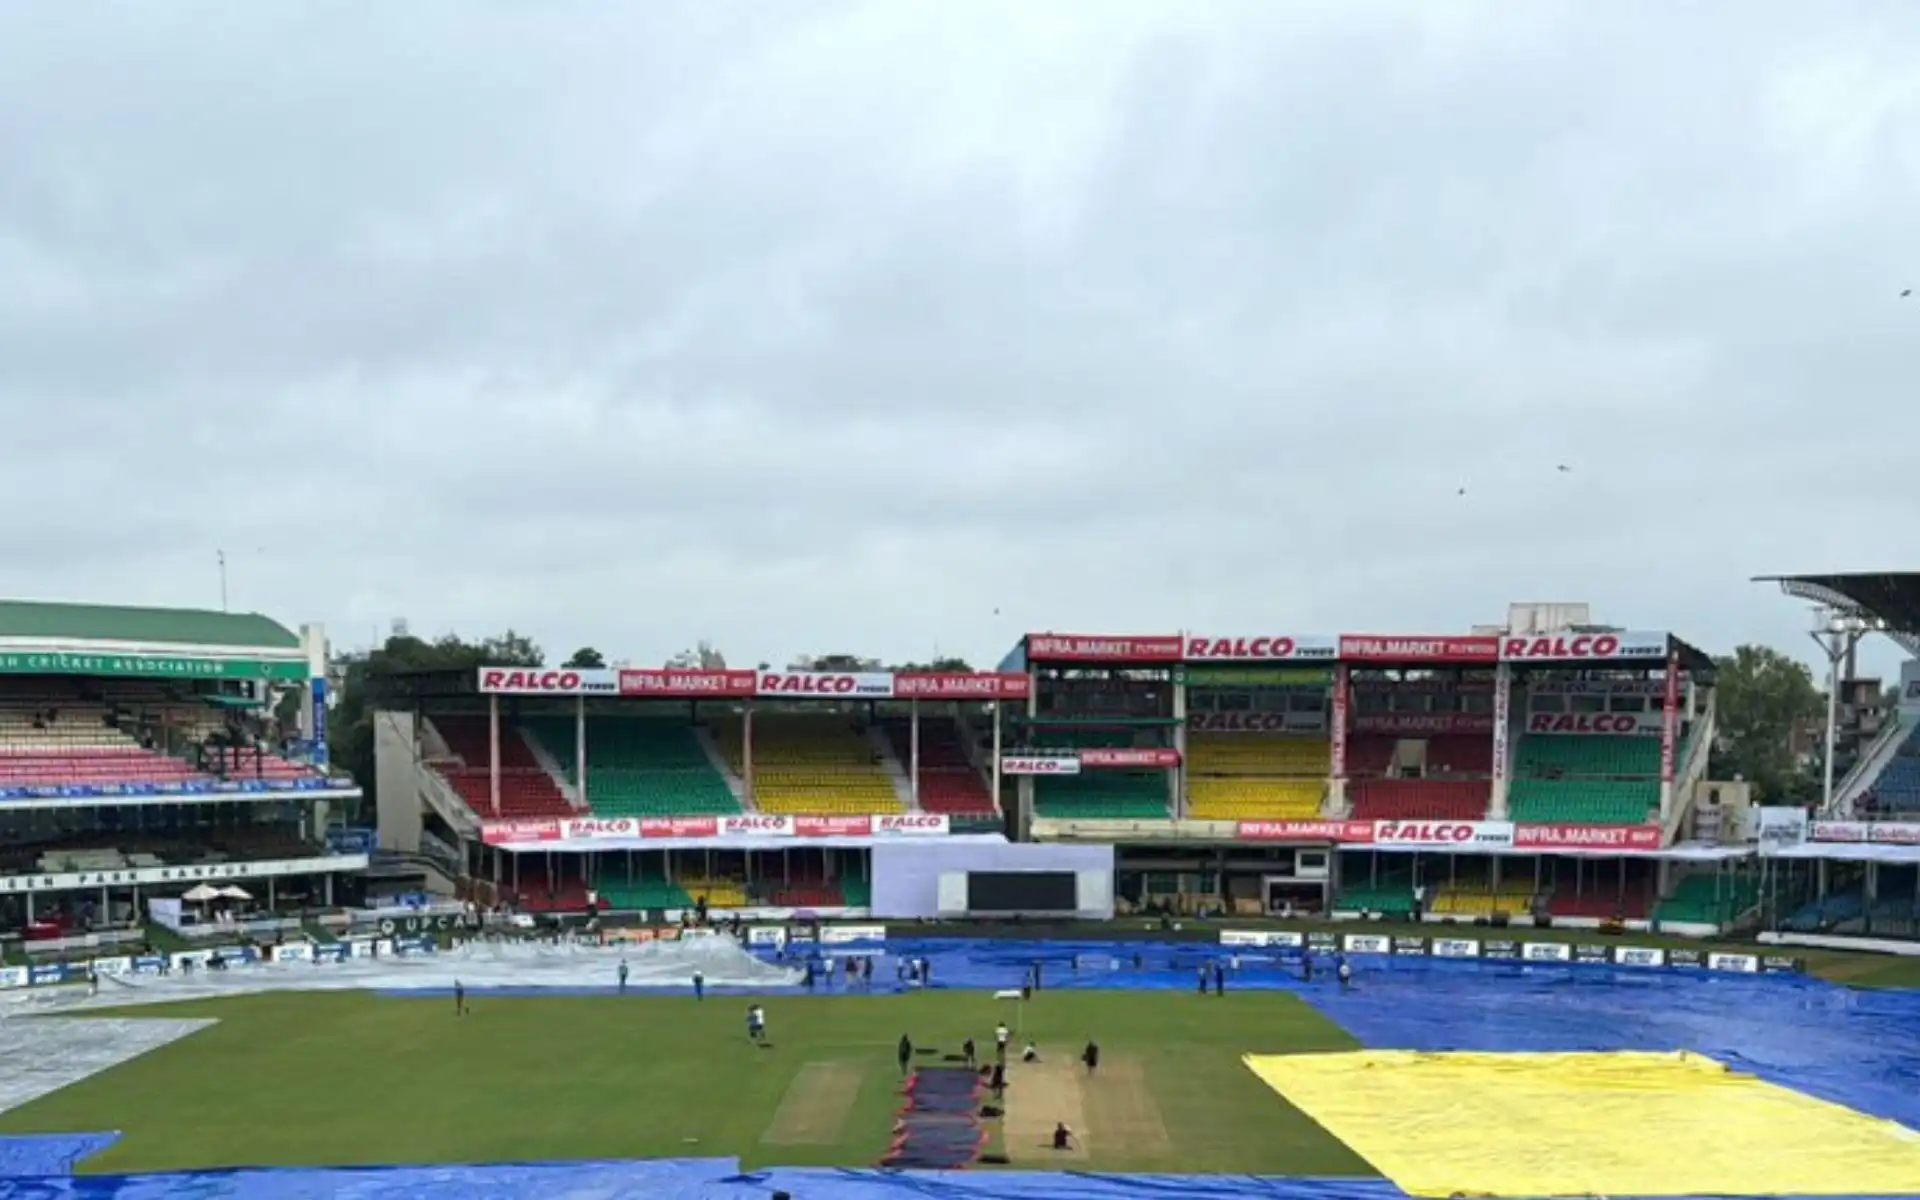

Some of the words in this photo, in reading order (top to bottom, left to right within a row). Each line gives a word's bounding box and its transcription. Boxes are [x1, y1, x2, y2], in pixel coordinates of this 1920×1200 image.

[1187, 637, 1295, 657] RALCO
[1504, 635, 1618, 656] RALCO
[27, 655, 103, 669] CRICKET
[113, 659, 224, 674] ASSOCIATION
[483, 672, 580, 690] RALCO
[761, 675, 856, 693] RALCO
[1190, 712, 1285, 730] RALCO
[1530, 714, 1636, 732] RALCO
[570, 819, 631, 832] RALCO
[725, 817, 785, 829] RALCO
[881, 816, 942, 828] RALCO
[1379, 825, 1474, 841] RALCO
[79, 871, 138, 884] PARK
